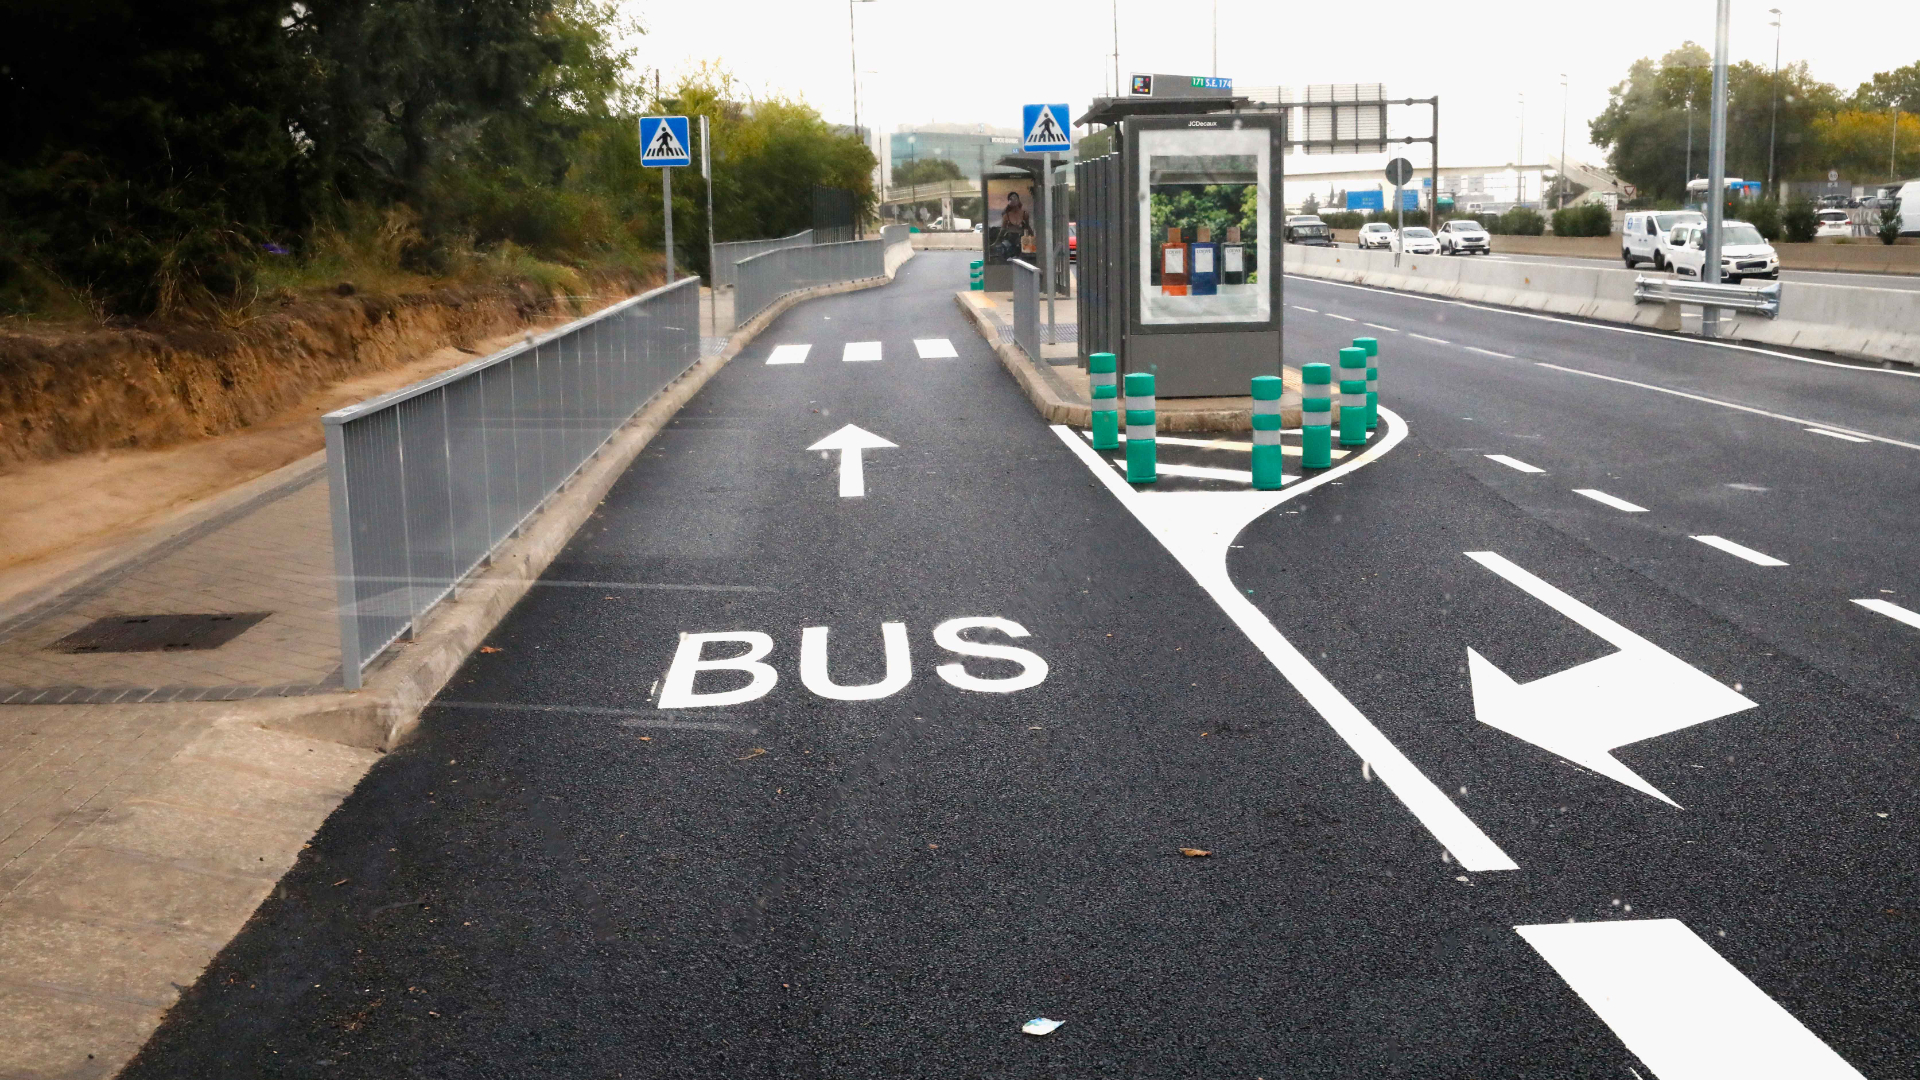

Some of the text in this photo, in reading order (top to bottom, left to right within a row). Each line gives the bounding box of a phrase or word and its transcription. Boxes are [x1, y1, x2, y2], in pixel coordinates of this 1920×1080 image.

[1192, 77, 1231, 89] 171 S.E. 174
[657, 616, 1049, 709] BUS
